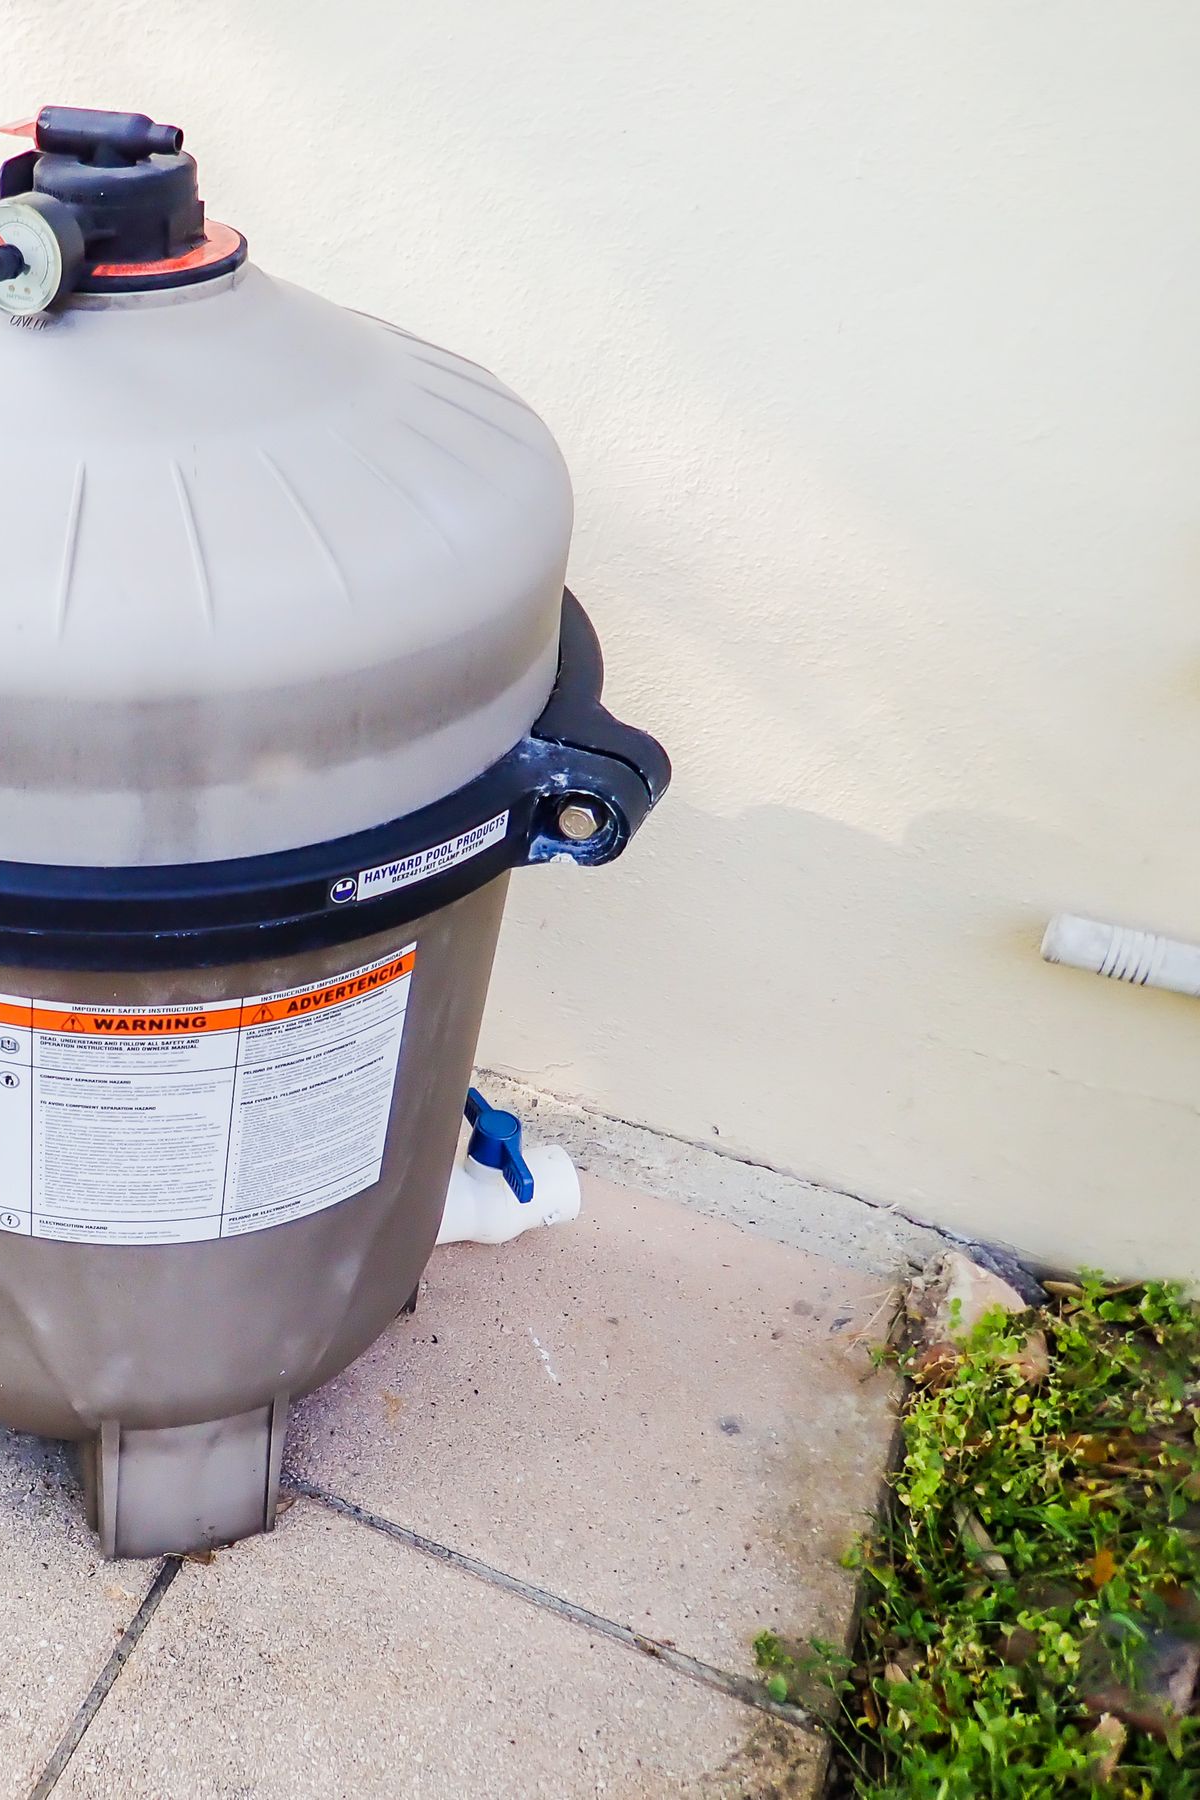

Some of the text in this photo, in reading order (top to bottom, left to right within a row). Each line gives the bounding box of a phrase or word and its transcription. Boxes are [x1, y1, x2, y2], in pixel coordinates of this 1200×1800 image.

[364, 855, 422, 884] HAYWARD
[426, 843, 453, 863] POOL
[456, 814, 506, 850] PRODUCTS
[438, 850, 460, 866] CLAMP
[461, 838, 485, 856] SYSTEM
[261, 950, 404, 1002] INSTRUCCIONES IMPORTANTES DE SEGURIDAD
[287, 960, 404, 1014] ADVERTENCIA
[71, 1005, 204, 1014] IMPORTANT SAFETY INSTRUCTIONS
[93, 1016, 207, 1031] WARNING
[40, 1041, 75, 1049] OPERATION
[60, 1038, 103, 1046] UNDERSTAND
